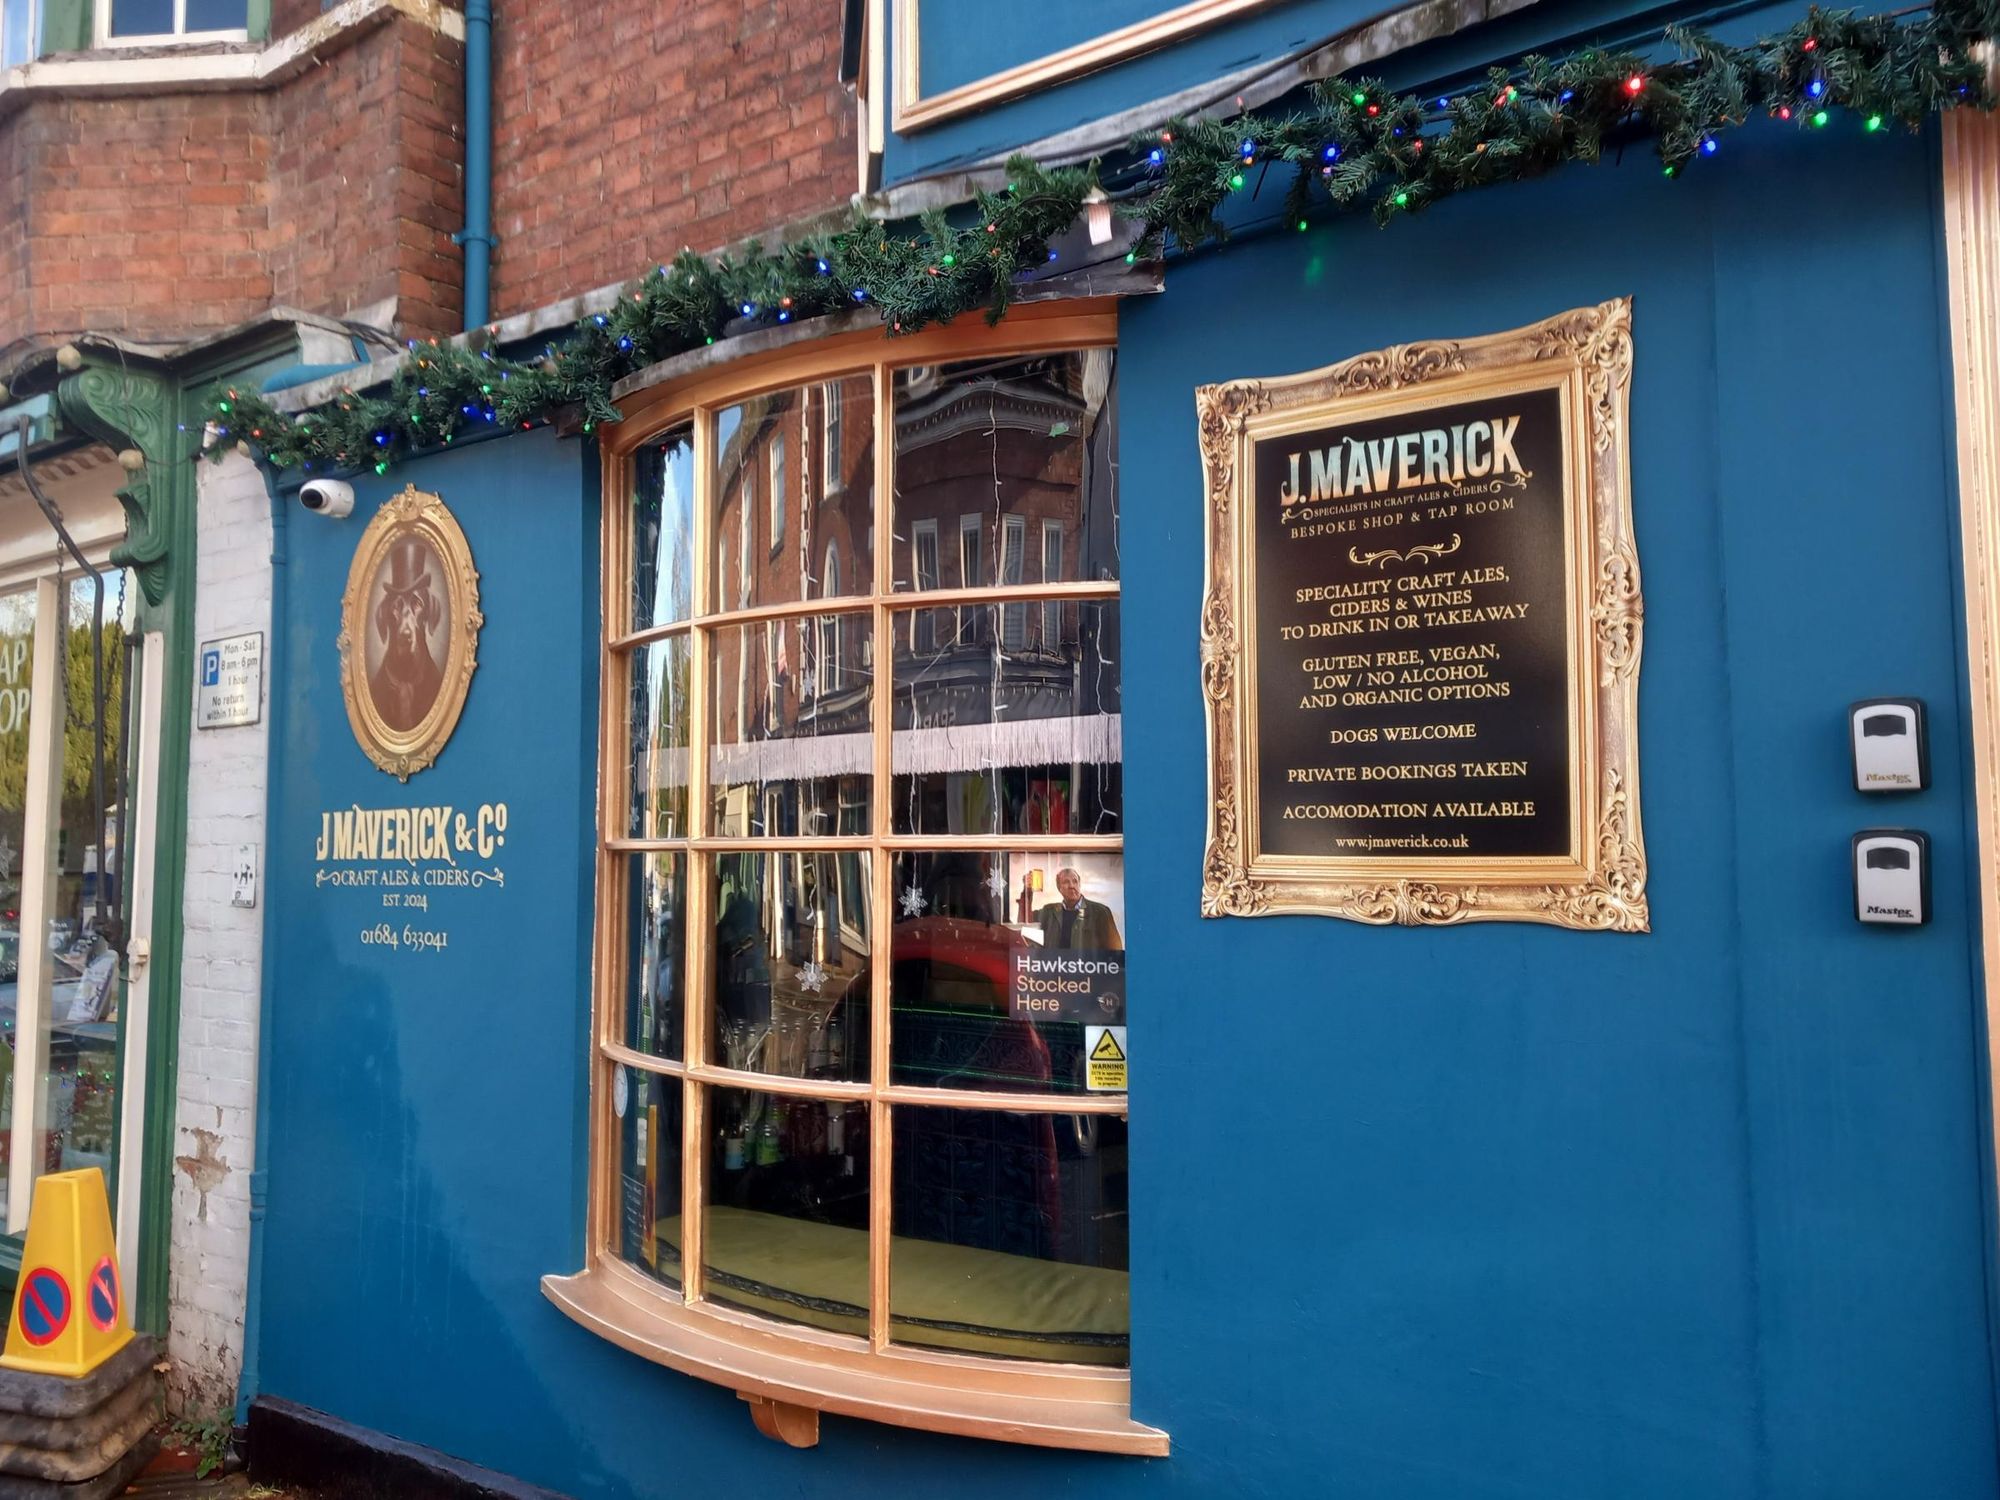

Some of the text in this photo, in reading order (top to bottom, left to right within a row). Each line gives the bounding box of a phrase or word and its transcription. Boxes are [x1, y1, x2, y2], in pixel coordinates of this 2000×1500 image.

[1314, 484, 1488, 518] SPECIALISTS IN CRAFT ALES & CIDERS
[1291, 497, 1515, 540] BESPOKE SHOP & TAP ROOM
[1296, 566, 1510, 603] SPECIALITY CRAFT ALES,
[1330, 589, 1472, 618] CIDERS & WINES
[1281, 604, 1530, 640] TO DRINK IN OR TAKEAWAY
[224, 644, 239, 654] Mon
[244, 640, 256, 651] Sat
[1302, 643, 1500, 672] GLUTEN FREE, VEGAN,
[207, 655, 217, 683] P
[1313, 664, 1488, 690] LOW / NO ALCOHOL
[212, 695, 244, 706] No return
[1299, 682, 1510, 709] AND ORGANIC OPTIONS
[207, 710, 226, 720] within
[1330, 724, 1477, 744] DOGS WELCOME
[1288, 761, 1528, 783] PRIVATE BOOKINGS TAKEN
[1283, 802, 1536, 819] ACCOMODATION AVAILABLE
[333, 804, 456, 866] MAVERICK
[455, 813, 476, 851] &
[1335, 834, 1469, 850] www.jmaverick.co.uk
[341, 870, 469, 886] CRAFT ALES & CIDERS
[404, 894, 427, 912] 2024
[1867, 906, 1911, 914] Master
[360, 924, 448, 952] 01684 633041
[1017, 956, 1119, 974] Hawkstone
[1017, 976, 1090, 994] Stocked
[1017, 995, 1060, 1012] Here
